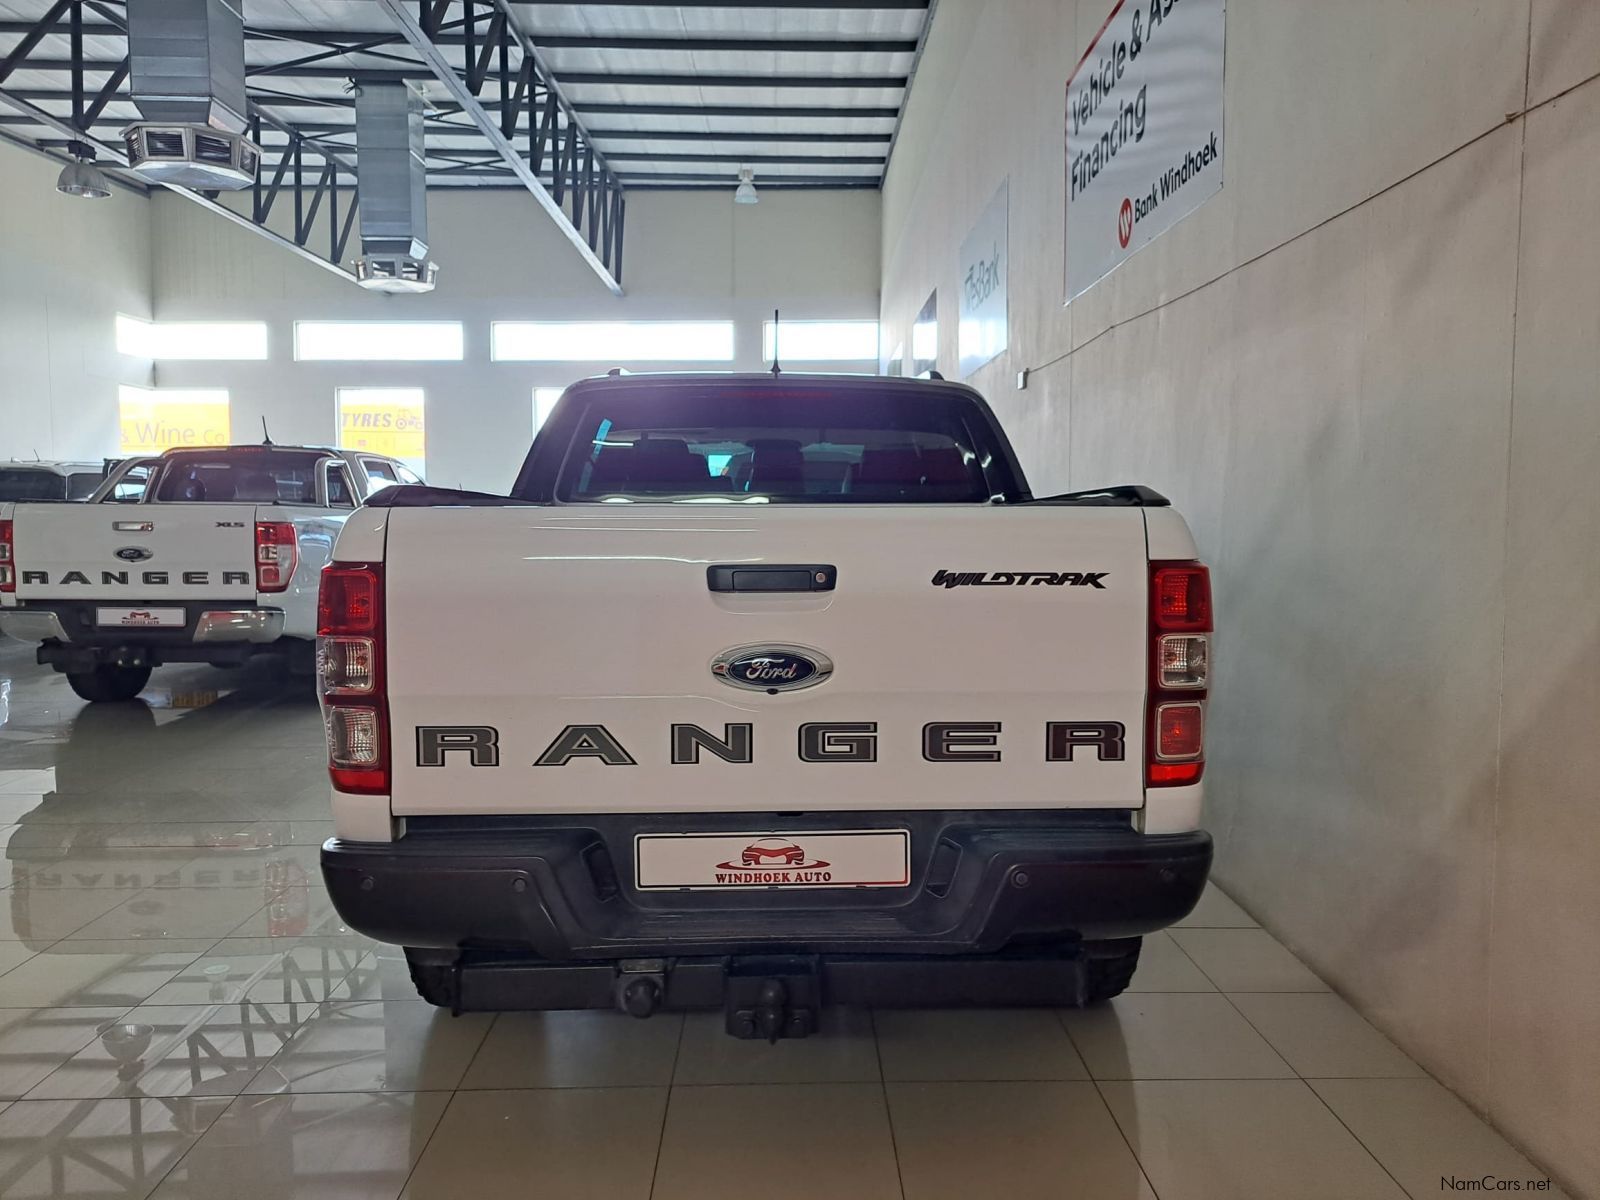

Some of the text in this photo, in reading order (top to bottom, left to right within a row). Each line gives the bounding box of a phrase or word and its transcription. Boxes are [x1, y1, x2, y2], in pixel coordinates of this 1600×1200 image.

[1073, 0, 1179, 136] Vehicle & As
[1071, 84, 1146, 202] Financing
[1134, 183, 1158, 223] Bank
[1160, 130, 1218, 201] Windhoek
[342, 412, 392, 428] TYRES
[135, 420, 195, 444] Wine
[22, 571, 250, 585] RANGER
[931, 569, 1111, 589] WILDTRAK
[735, 657, 798, 680] Ford
[415, 721, 1125, 767] RANGER
[715, 871, 832, 884] WINDHOEK AUTO
